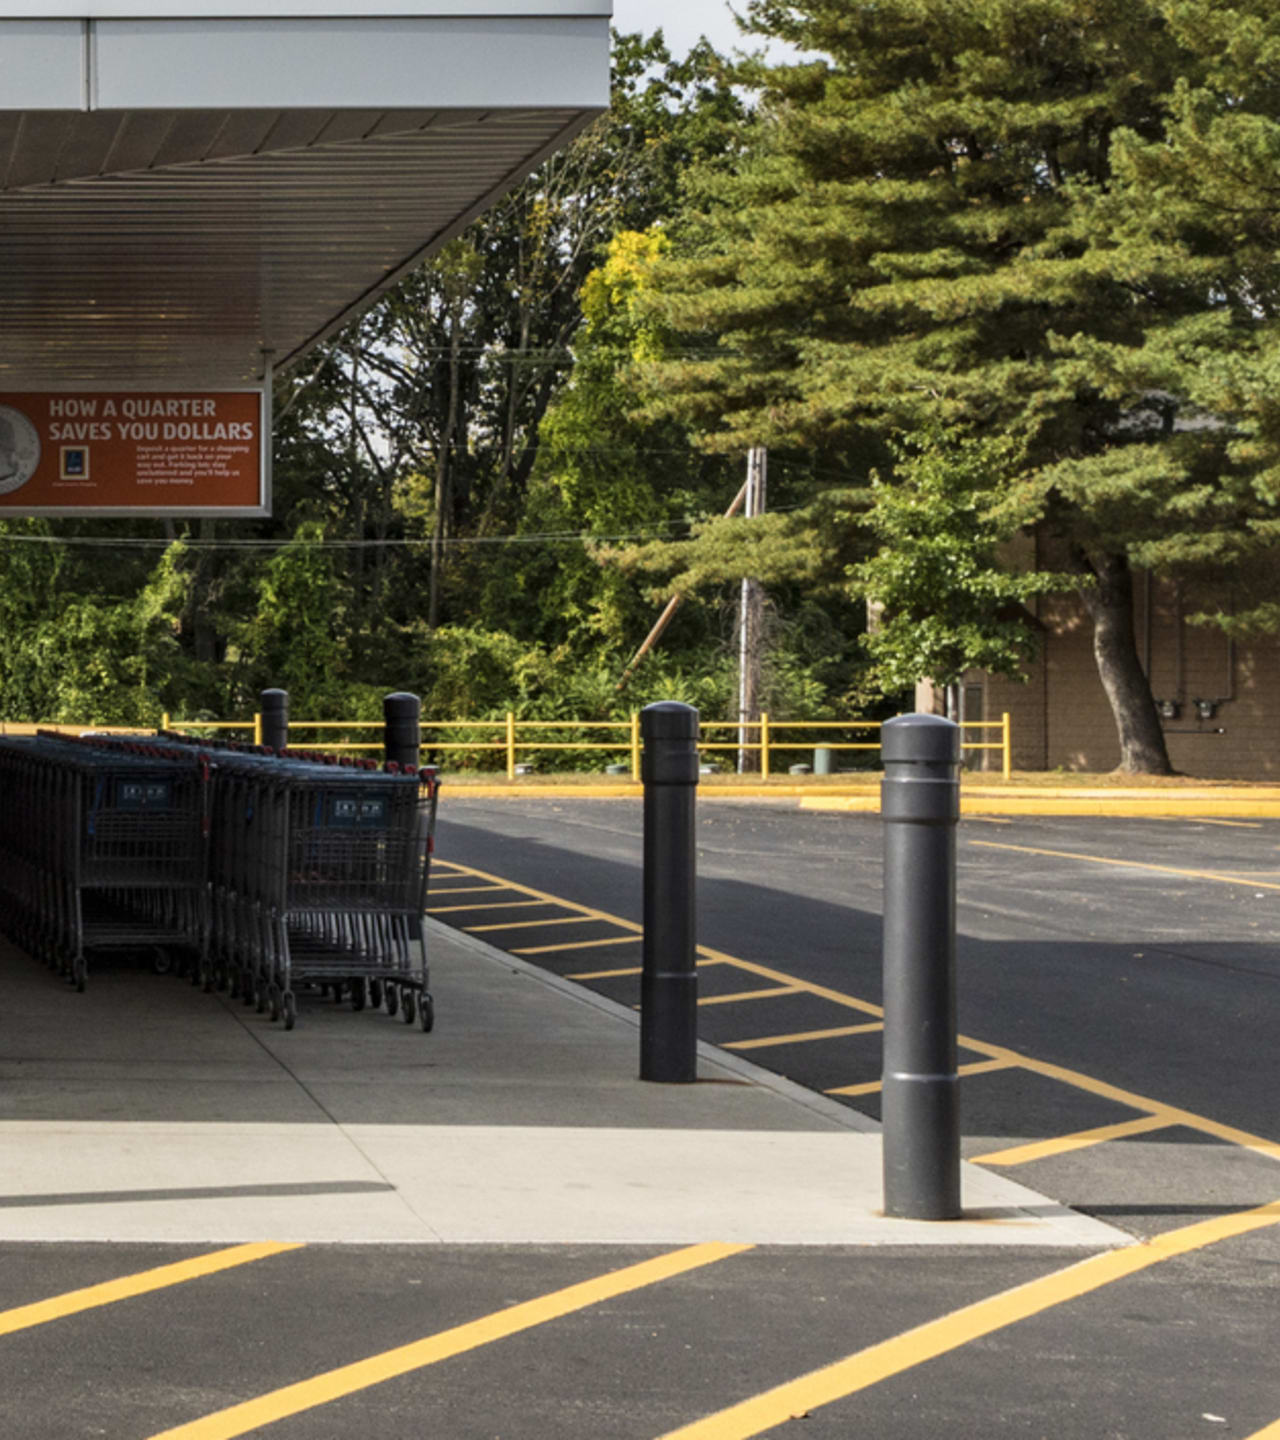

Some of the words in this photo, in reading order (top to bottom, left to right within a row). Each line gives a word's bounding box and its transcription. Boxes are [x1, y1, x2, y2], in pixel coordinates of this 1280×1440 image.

[49, 400, 97, 417] HOW
[102, 400, 118, 417] A
[121, 400, 217, 419] QUARTER
[48, 422, 112, 441] SAVES
[117, 422, 159, 441] YOU
[163, 422, 254, 441] DOLLARS
